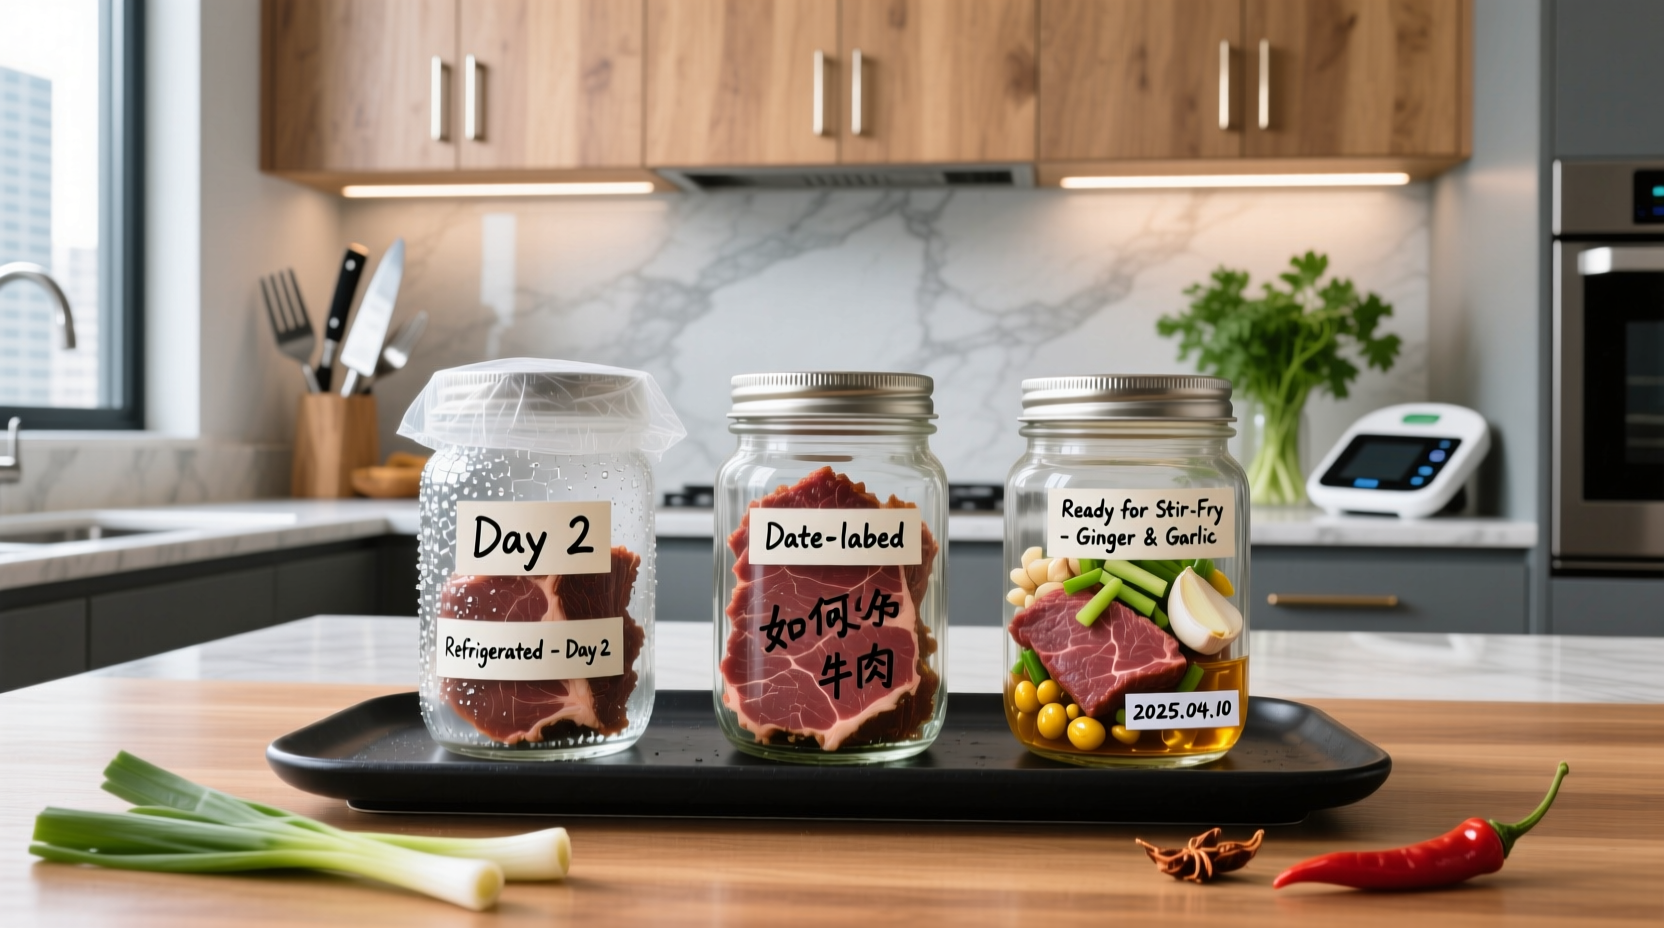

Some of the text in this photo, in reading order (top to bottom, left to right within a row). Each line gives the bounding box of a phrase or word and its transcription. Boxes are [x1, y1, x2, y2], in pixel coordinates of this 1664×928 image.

[1061, 498, 1224, 527] Ready for Stir-Fry
[473, 514, 595, 572] Day 2
[765, 521, 905, 551] Date-labed
[1076, 526, 1136, 554] Ginger
[1143, 526, 1158, 547] &
[1165, 525, 1218, 546] Garlic
[445, 636, 544, 669] Refrigerated
[565, 638, 597, 666] Day
[600, 638, 611, 657] 2
[818, 642, 895, 700] 牛肉
[1132, 699, 1232, 721] 2025.04.10
